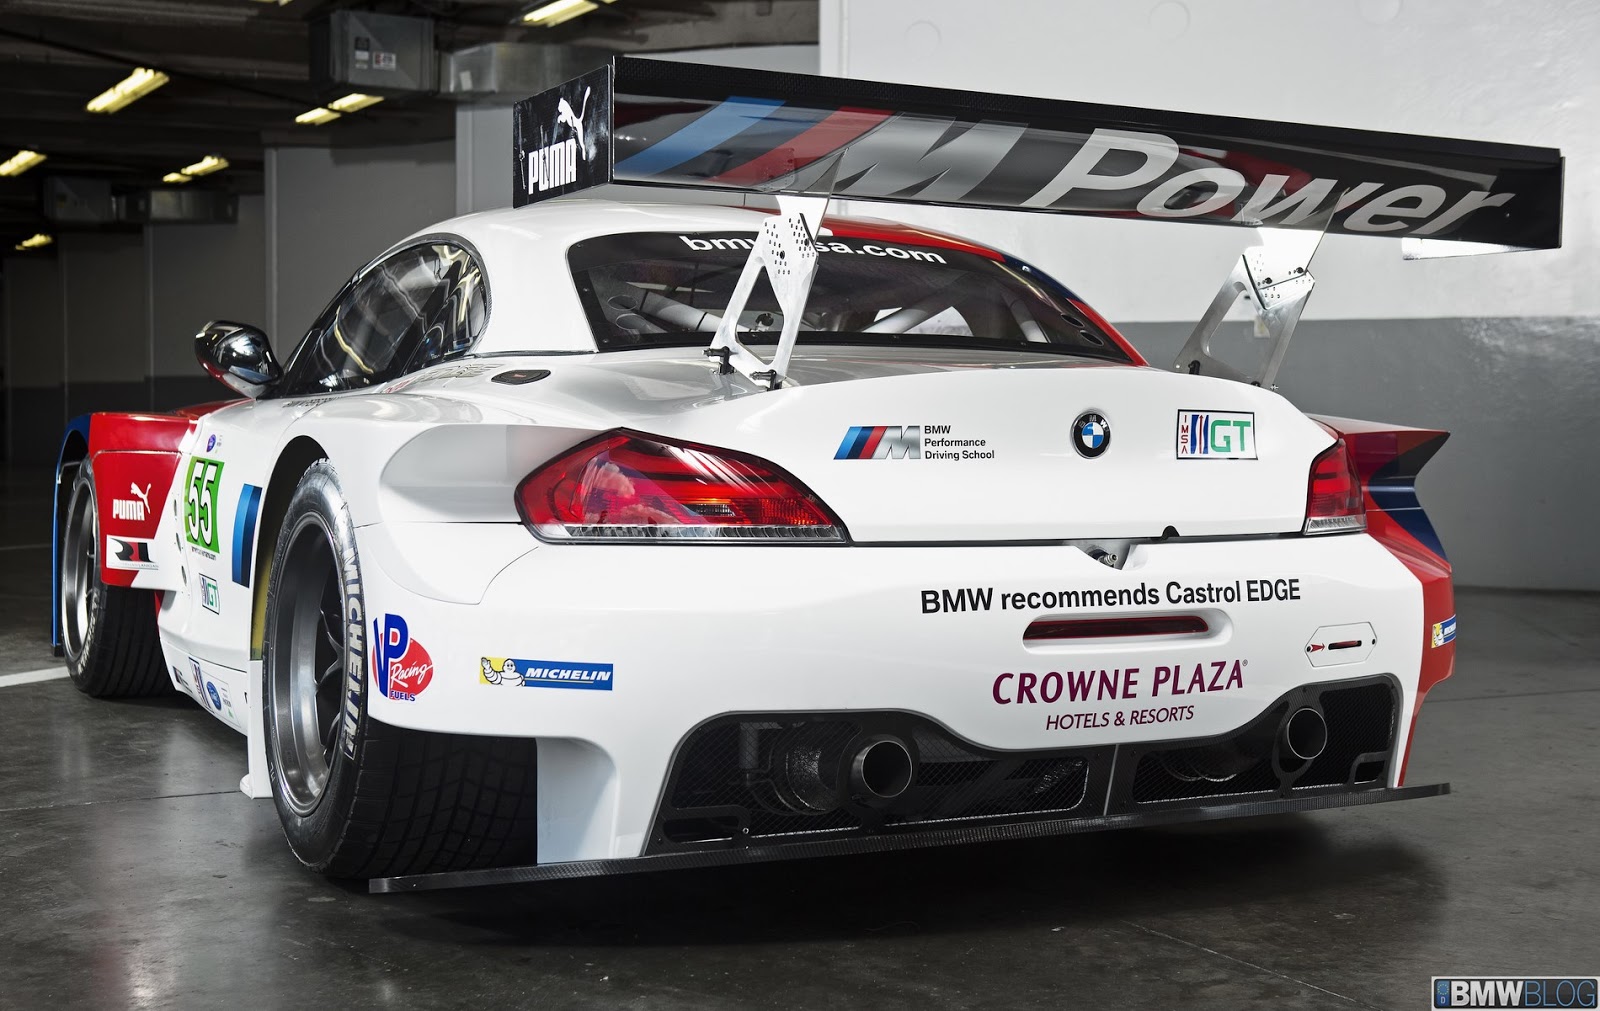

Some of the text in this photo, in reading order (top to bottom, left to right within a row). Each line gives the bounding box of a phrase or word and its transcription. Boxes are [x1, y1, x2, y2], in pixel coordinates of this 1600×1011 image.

[528, 139, 577, 195] PUMA
[1019, 127, 1517, 236] Power
[679, 235, 947, 265] bmsa.com
[924, 425, 951, 434] BMW
[924, 438, 986, 447] Performance
[1210, 419, 1251, 453] GT
[925, 450, 995, 461] Driving School
[112, 498, 146, 521] PUMA
[187, 459, 218, 547] 55
[921, 578, 1301, 614] BMW recommends Castrol EDGE
[342, 547, 364, 757] MICHELIN
[373, 613, 409, 698] VP
[390, 660, 434, 689] Racing
[525, 667, 611, 682] MICHELIN
[992, 667, 1140, 705] CROWNE
[390, 690, 416, 702] FUELS
[1045, 704, 1195, 731] HOTELS & RESORTS
